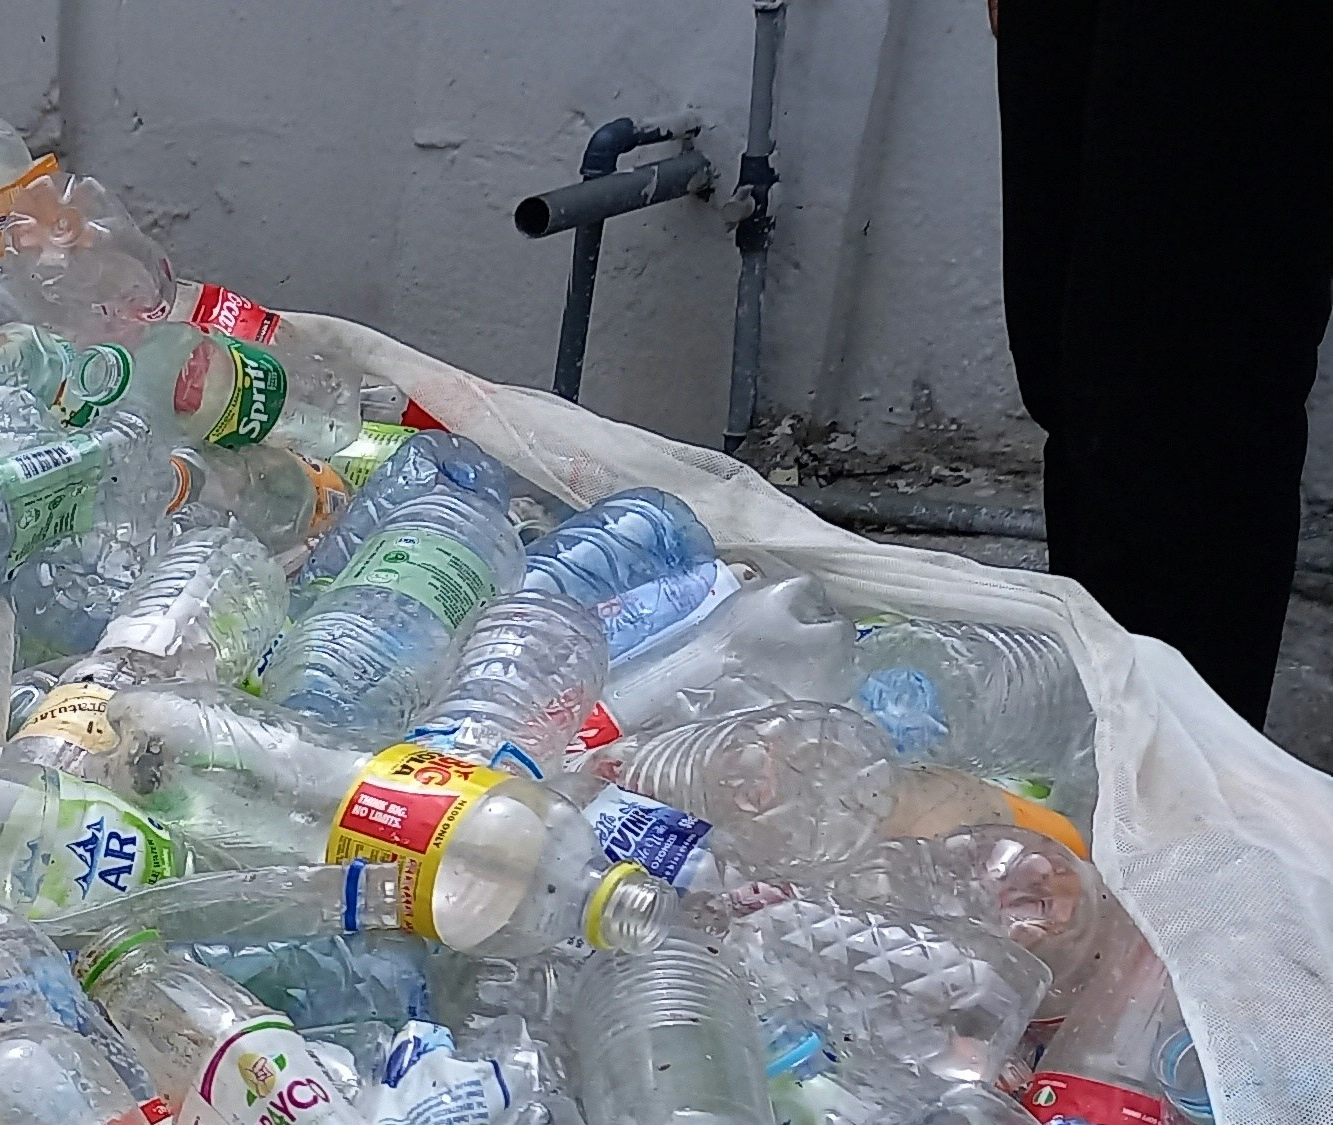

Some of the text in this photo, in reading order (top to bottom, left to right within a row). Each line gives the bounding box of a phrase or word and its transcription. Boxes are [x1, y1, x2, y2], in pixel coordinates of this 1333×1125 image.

[351, 804, 368, 817] NO
[359, 793, 389, 811] THINK
[433, 821, 451, 849] ONLY
